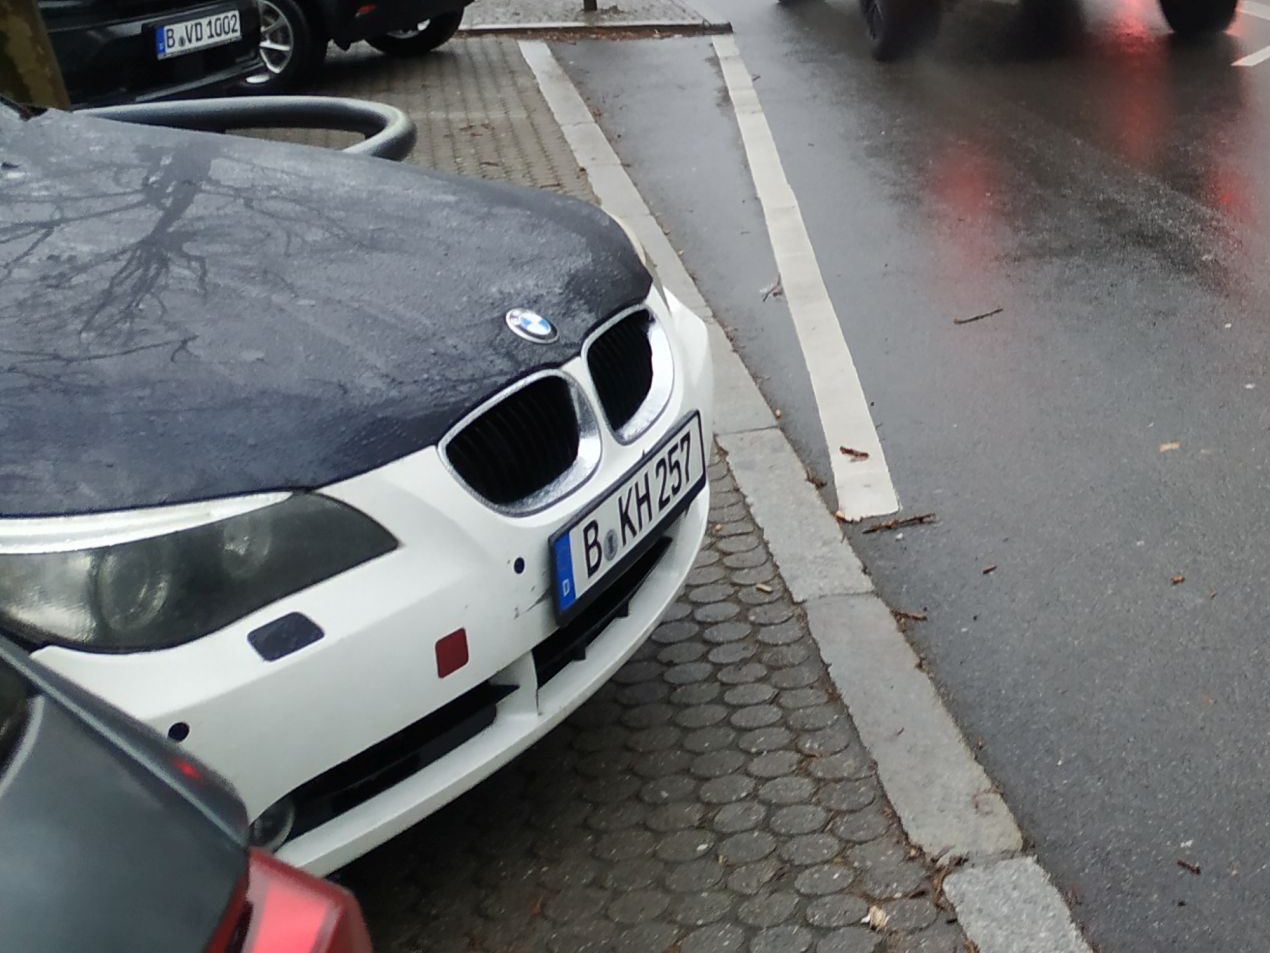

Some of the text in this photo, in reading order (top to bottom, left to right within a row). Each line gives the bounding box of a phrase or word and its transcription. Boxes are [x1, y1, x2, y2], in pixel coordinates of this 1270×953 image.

[166, 14, 238, 48] B VD 1002
[583, 432, 691, 579] B KH 257
